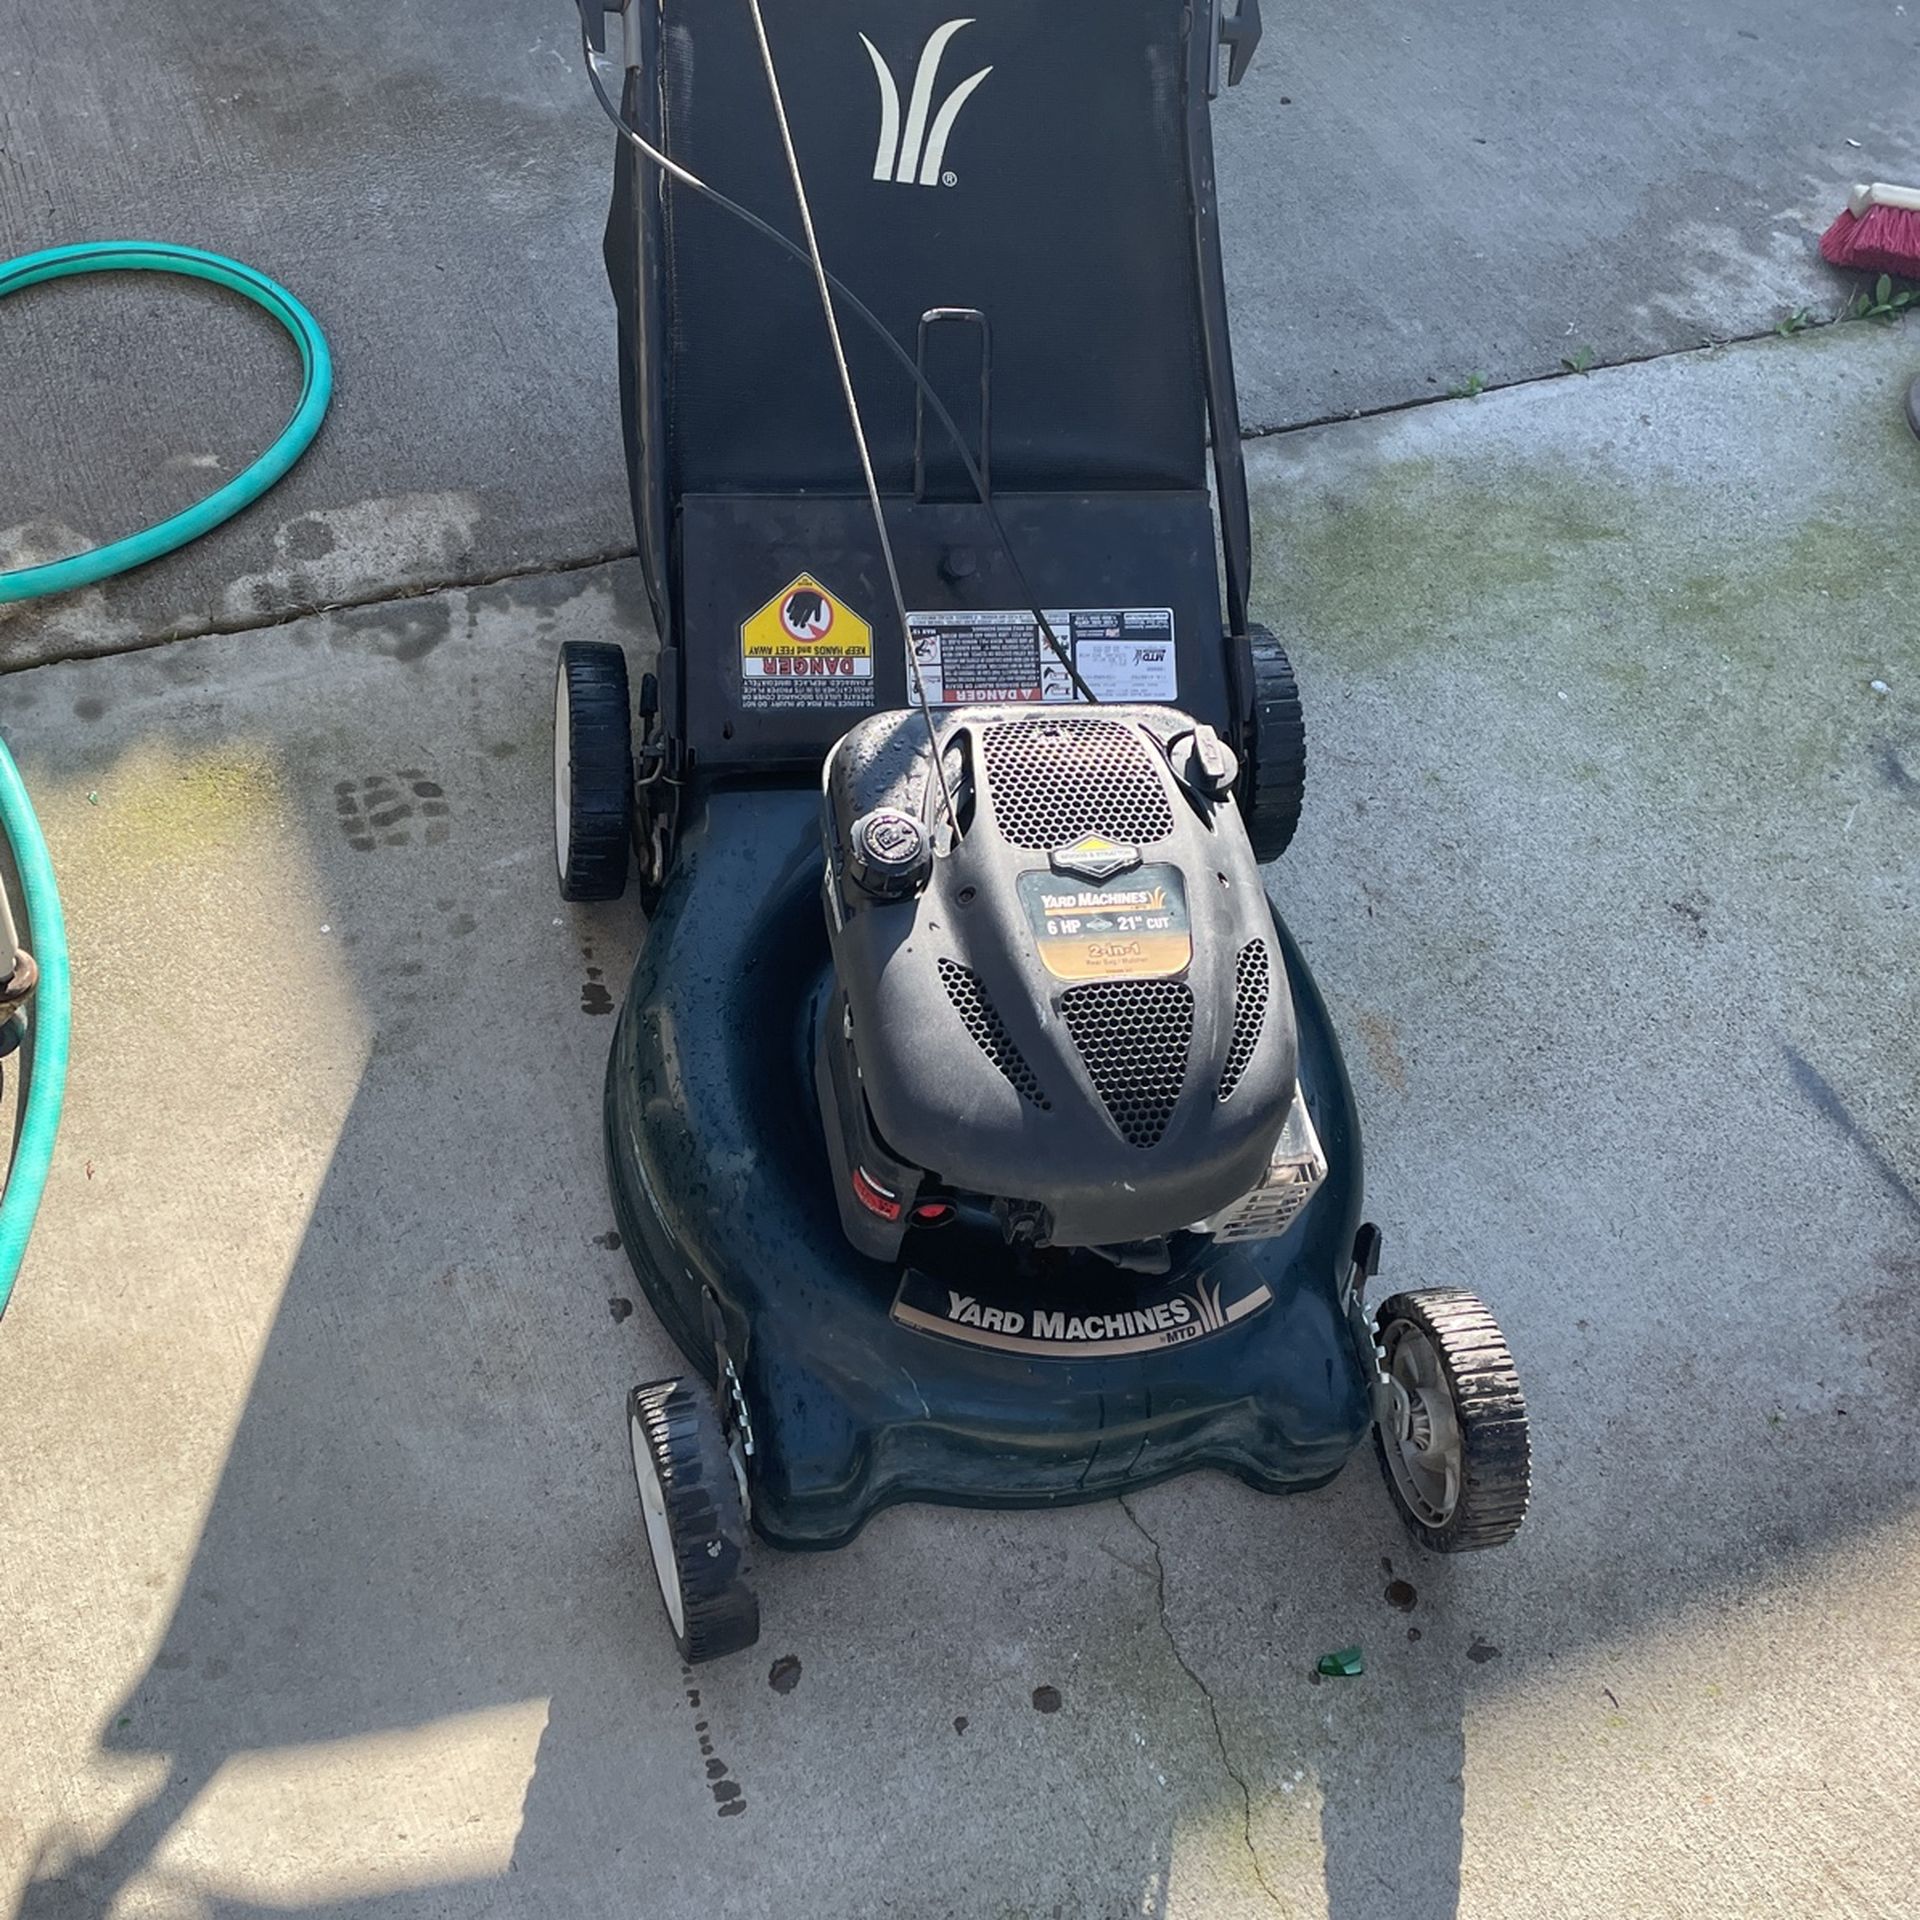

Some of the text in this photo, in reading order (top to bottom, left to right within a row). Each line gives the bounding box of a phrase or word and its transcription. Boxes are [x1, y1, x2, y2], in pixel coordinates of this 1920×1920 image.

[749, 646, 865, 656] KEEP HANDS and FEET AWAY
[1143, 654, 1164, 662] MTD
[763, 657, 854, 675] DANGER
[956, 690, 1017, 700] DANGER
[1041, 890, 1148, 908] YARD MACHINES
[1046, 916, 1170, 936] 6 HP 21" CUT
[1088, 941, 1140, 958] 2-in-1
[947, 1291, 1190, 1341] YARD MACHINES
[1166, 1326, 1196, 1343] MTD
